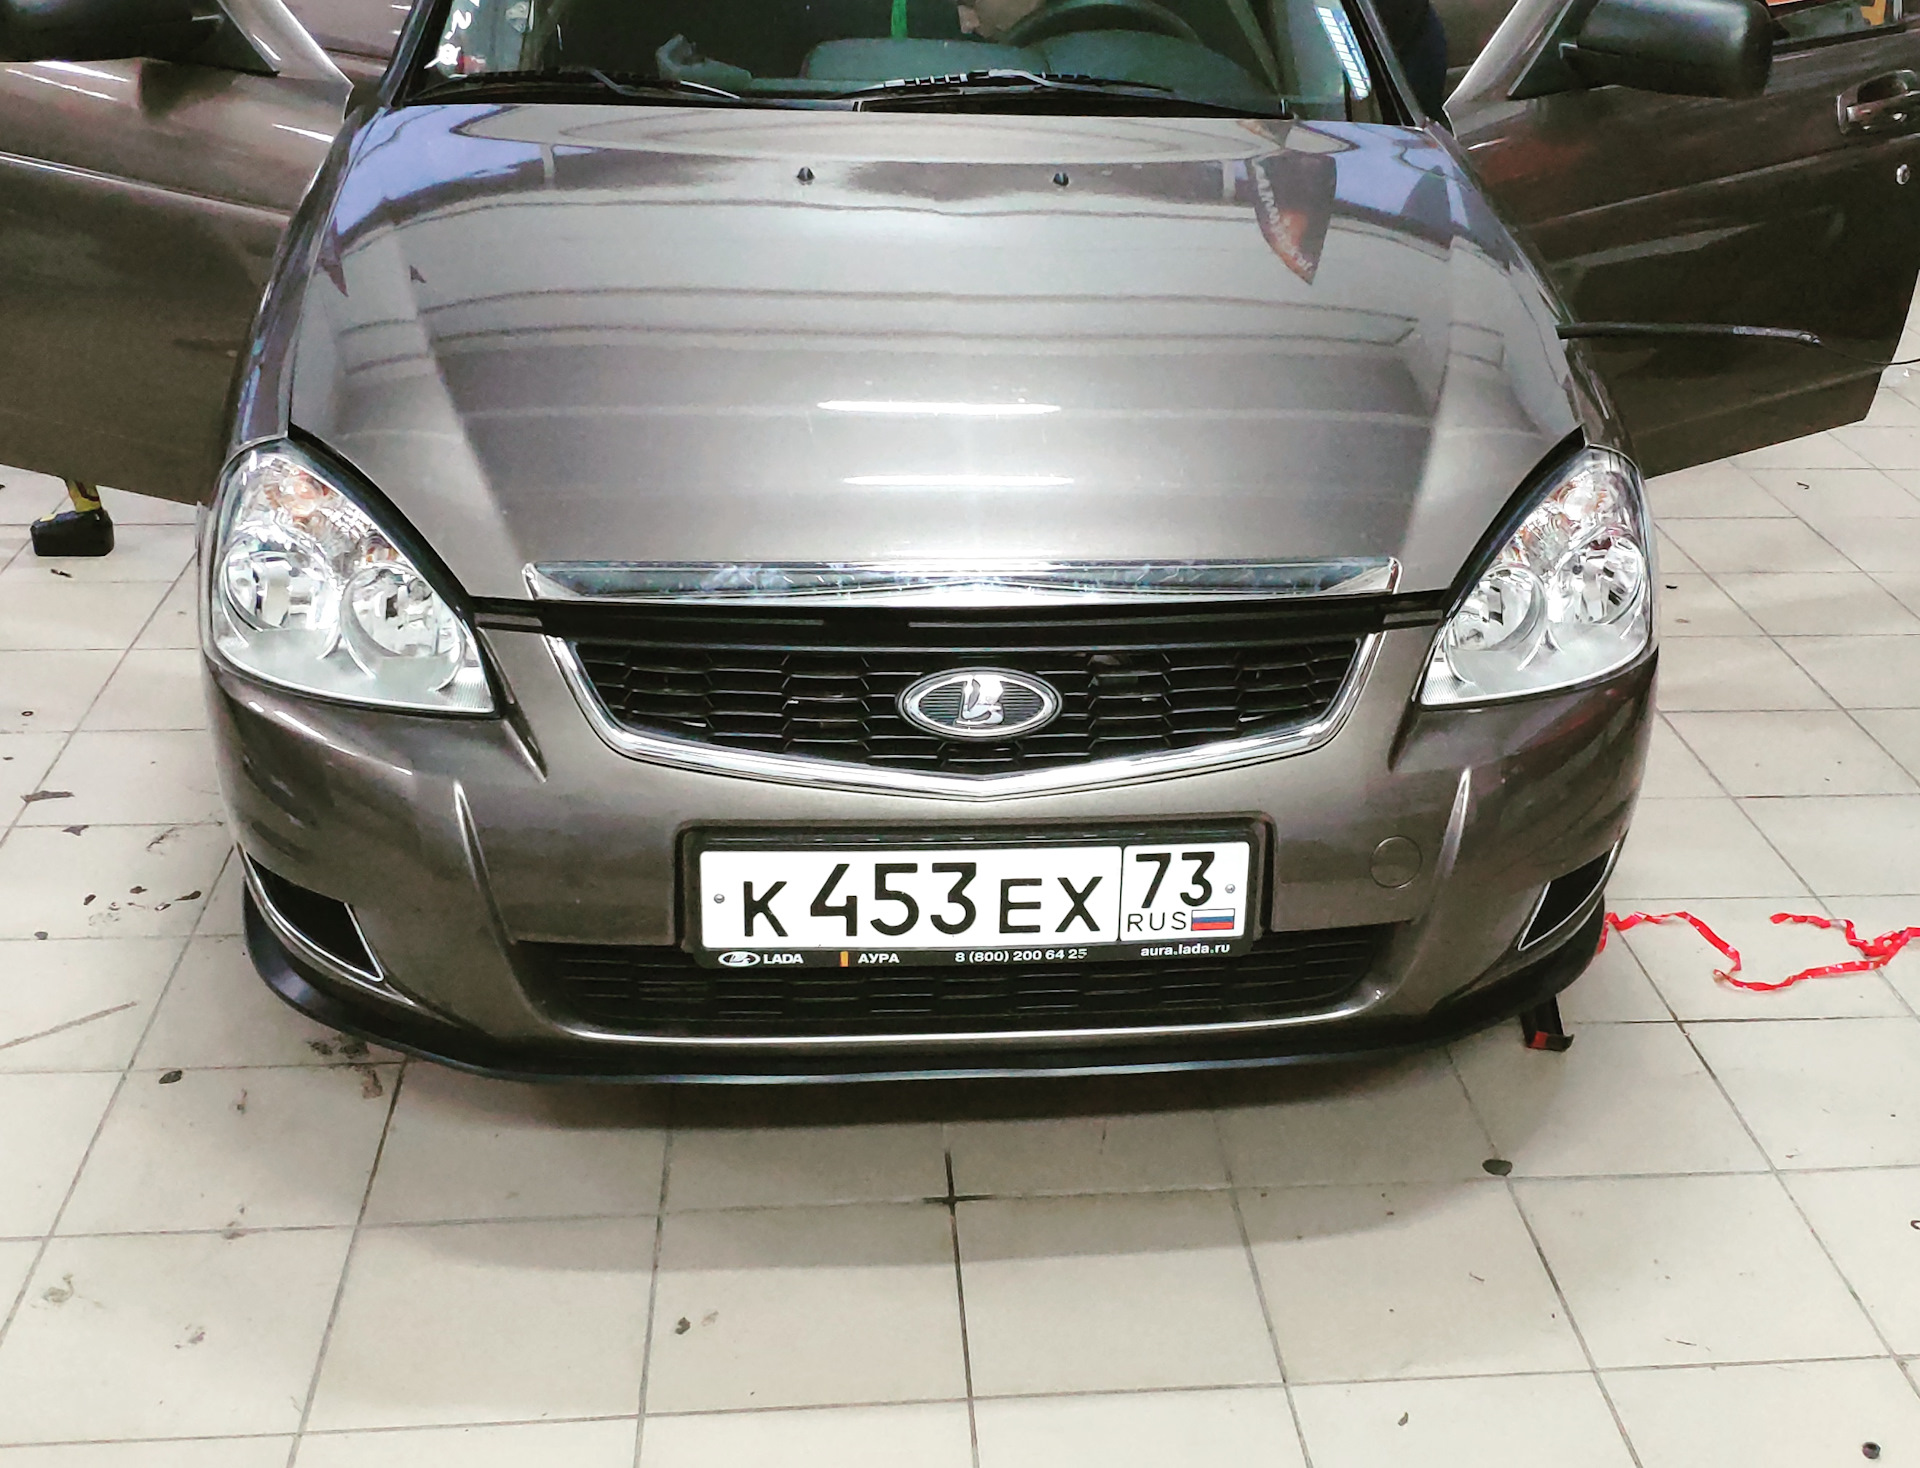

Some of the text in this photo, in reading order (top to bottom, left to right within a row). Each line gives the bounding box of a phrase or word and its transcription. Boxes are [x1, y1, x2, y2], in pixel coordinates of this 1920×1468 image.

[1135, 852, 1215, 908] 73
[1127, 912, 1187, 933] RUS
[954, 948, 1088, 964] 8 (800) 200 64 25
[1140, 943, 1231, 958] aura.lada.ru
[763, 953, 804, 965] LADA
[857, 952, 900, 965] АУРА
